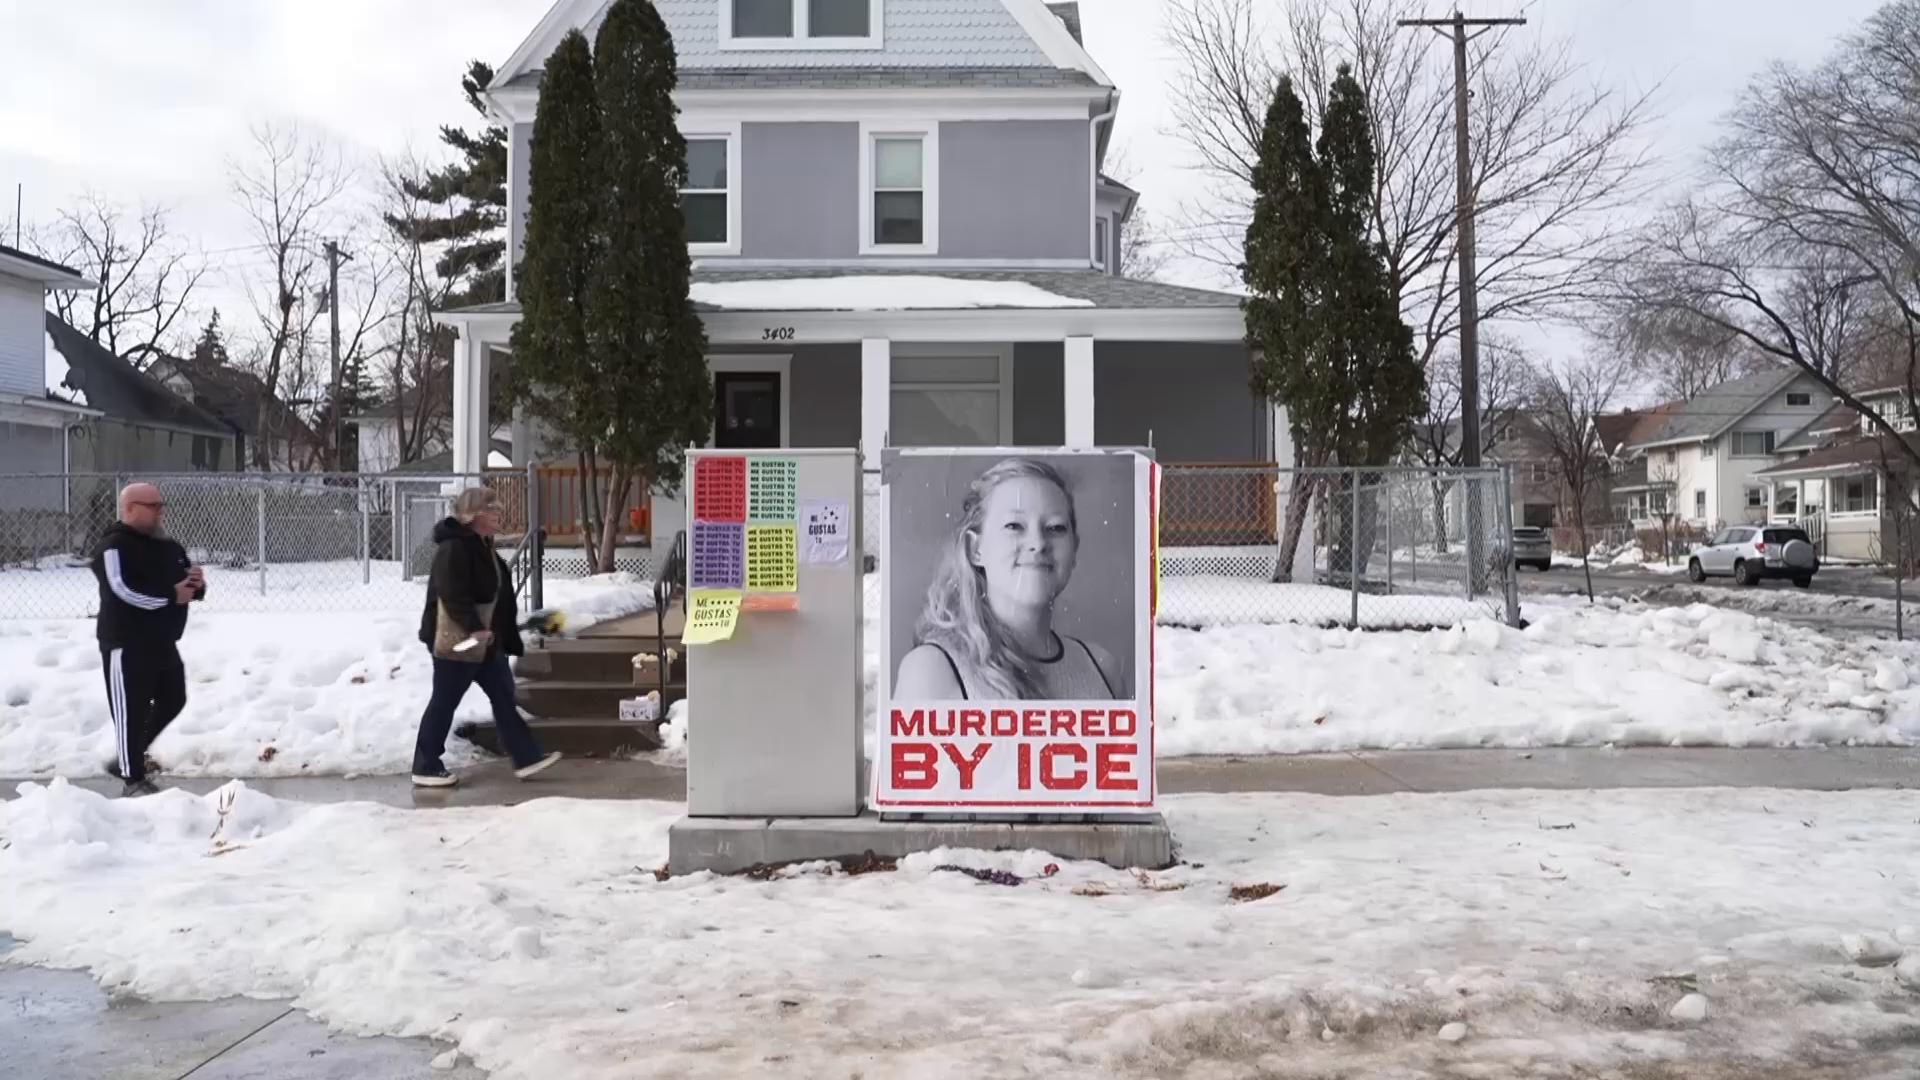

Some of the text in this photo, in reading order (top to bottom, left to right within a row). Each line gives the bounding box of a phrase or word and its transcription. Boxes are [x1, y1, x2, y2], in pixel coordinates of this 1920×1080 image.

[762, 327, 795, 340] 3402
[809, 524, 837, 536] GUSTAS
[696, 598, 708, 608] ME
[694, 609, 732, 620] GUSTAS
[890, 709, 1137, 737] MURDERED
[891, 743, 1138, 790] BY ICE
